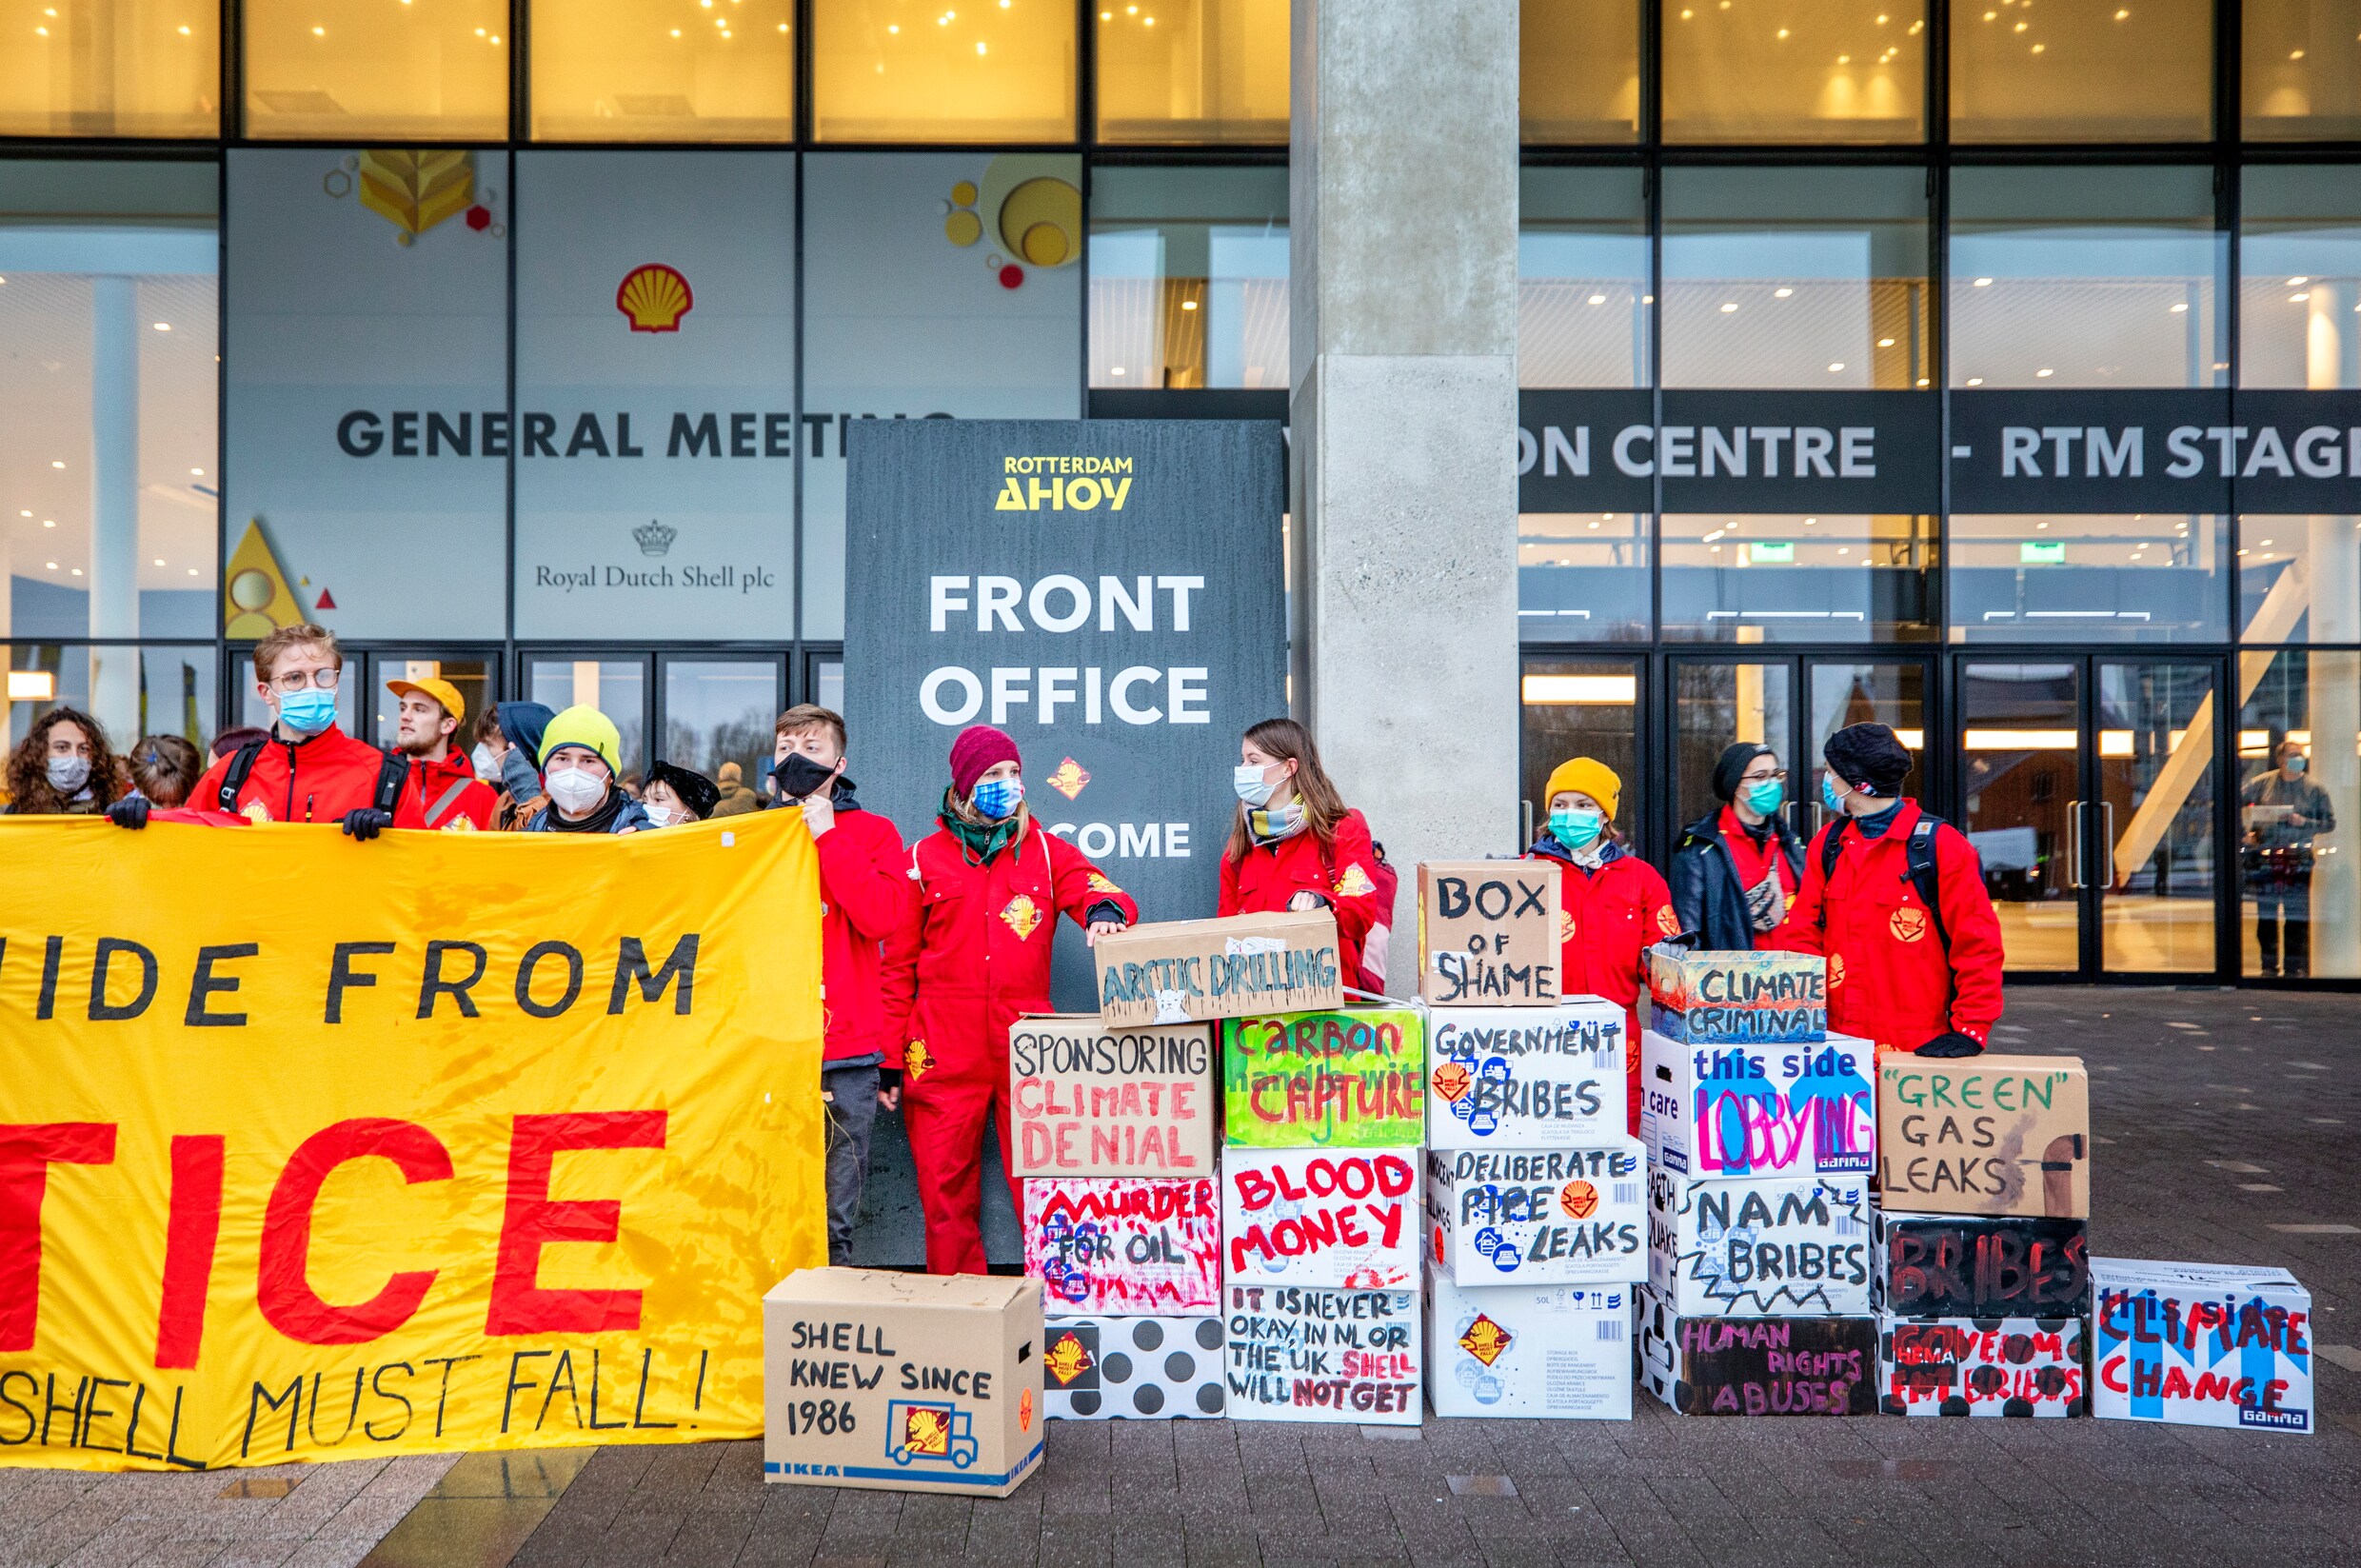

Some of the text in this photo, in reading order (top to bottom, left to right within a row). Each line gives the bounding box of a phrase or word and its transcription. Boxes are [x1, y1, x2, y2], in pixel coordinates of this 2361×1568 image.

[337, 410, 956, 458] GENERAL MEETI
[1612, 425, 1876, 479] CENTRE
[2000, 426, 2145, 478] RTM
[1004, 456, 1133, 474] ROTTERDAM
[995, 477, 1133, 511] AHOY
[536, 566, 775, 594] Royal Dutch Shell plc
[929, 574, 1205, 633] FRONT
[919, 665, 1211, 726] OFFICE
[1438, 877, 1546, 921] BOX
[1467, 932, 1510, 956] OF
[0, 933, 700, 1026] IDE FROM
[1102, 946, 1337, 1005] ARCTIC DRILLING
[1435, 952, 1557, 1002] SHAME
[1701, 969, 1825, 1002] CLIMATE
[1435, 1022, 1621, 1058] GOVERNMENT
[1688, 1005, 1826, 1036] CRIMINAL
[1012, 1032, 1208, 1078] SPONSORING
[1694, 1045, 1855, 1081] this side
[1011, 1076, 1197, 1121] CLIMATE
[1250, 1070, 1423, 1124] CAPTURE
[1476, 1076, 1601, 1120] BRIBES
[1650, 1090, 1678, 1120] care
[1022, 1120, 1199, 1170] DENIAL
[1697, 1087, 1875, 1172] LOBBYING
[1901, 1115, 1995, 1148] GAS
[1234, 1155, 1415, 1212] BLOOD
[1455, 1151, 1628, 1182] DELIBERATE
[1882, 1155, 2008, 1196] LEAKS
[1041, 1180, 1216, 1226] MURDER
[1460, 1185, 1556, 1226] PIPE
[1698, 1190, 1830, 1234] NAM
[1059, 1225, 1186, 1266] FOR OIL
[1231, 1202, 1401, 1274] MONEY
[1526, 1221, 1639, 1263] LEAKS
[1727, 1239, 1867, 1285] BRIBES
[1889, 1228, 2089, 1305] BRIBES
[1232, 1287, 1394, 1320] IT IS NEVER
[1536, 1296, 1551, 1304] 50L
[2098, 1286, 2289, 1328] this side
[790, 1320, 897, 1357] SHELL
[1304, 1321, 1327, 1347] IN
[1334, 1322, 1367, 1349] NL
[1368, 1326, 1411, 1352] OR
[1681, 1321, 1791, 1353] HUMAN
[2099, 1293, 2311, 1356] CLIMATE
[1229, 1342, 1280, 1372] THE
[1341, 1350, 1418, 1379] SHELL
[1767, 1348, 1862, 1381] RIGHTS
[1897, 1347, 1955, 1364] HEMA
[789, 1358, 993, 1400] KNEW SINCE
[1227, 1372, 1291, 1405] WILL
[1293, 1379, 1351, 1410] NOT
[1350, 1381, 1419, 1413] GET
[1712, 1380, 1850, 1416] ABUSES
[1964, 1367, 2083, 1405] BRIBES
[2101, 1355, 2290, 1417] CHANGE
[0, 1348, 708, 1470] SHELL MUST FALL!
[787, 1399, 856, 1436] 1986
[784, 1461, 840, 1478] IKEA
